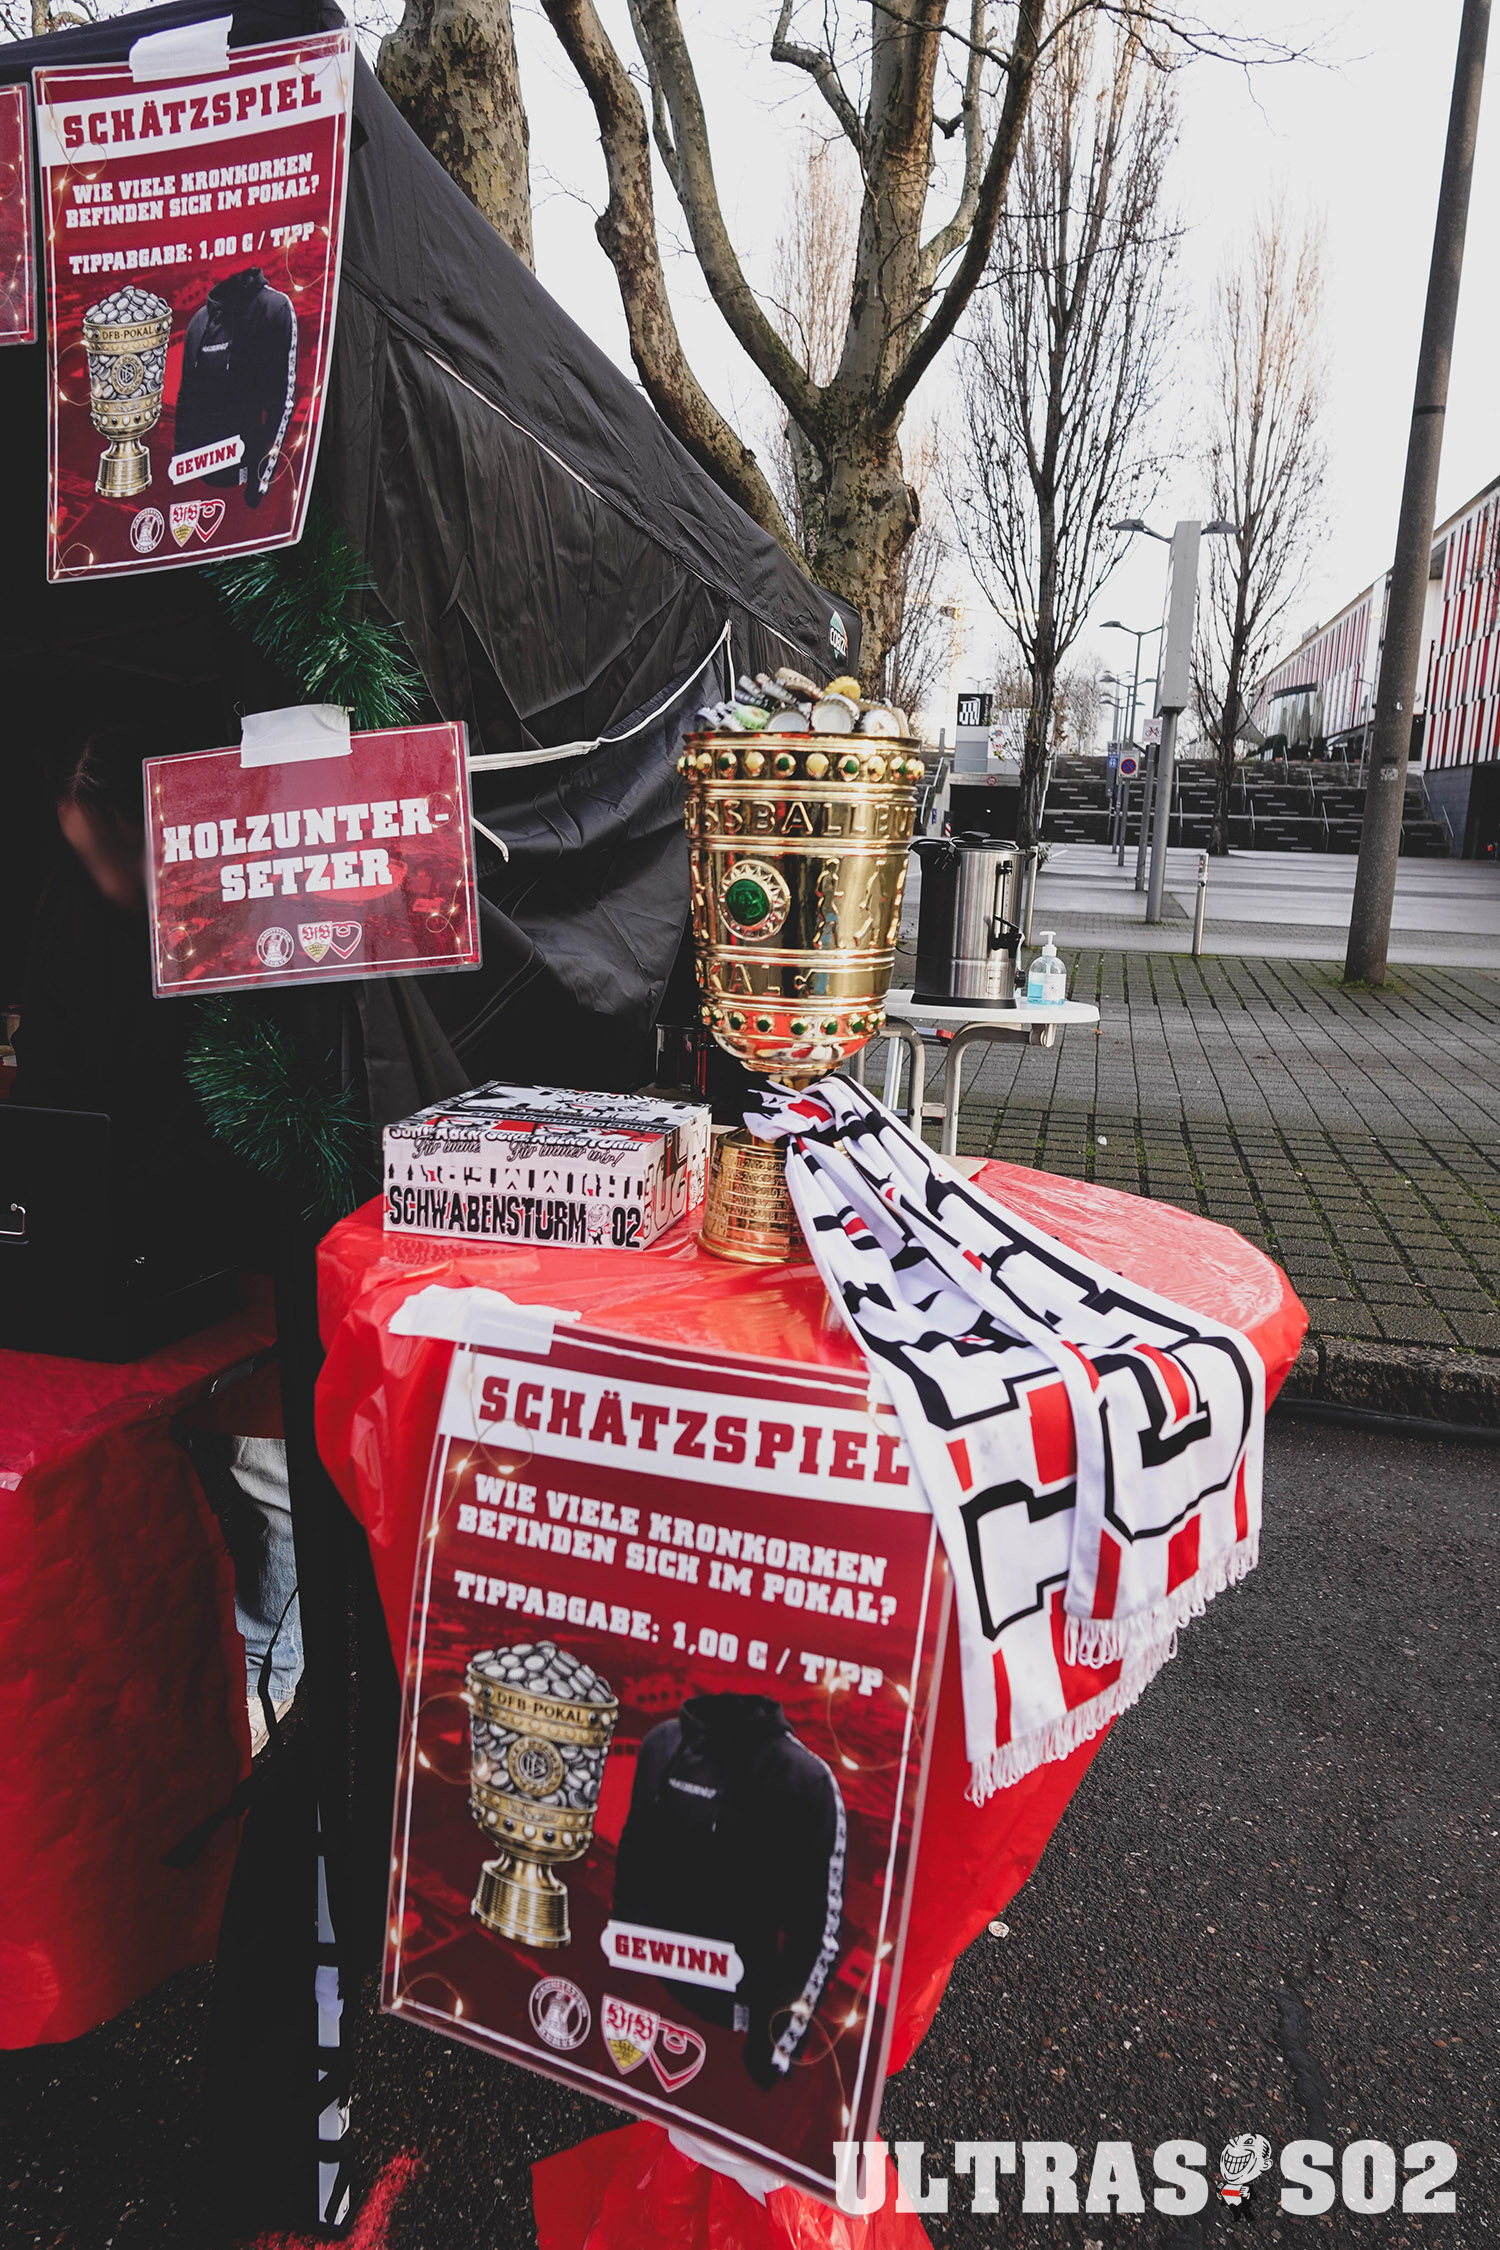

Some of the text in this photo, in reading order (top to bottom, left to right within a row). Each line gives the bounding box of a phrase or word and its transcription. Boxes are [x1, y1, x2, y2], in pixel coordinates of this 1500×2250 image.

[63, 73, 322, 149] SCHÄTZSPIEL
[66, 174, 320, 228] BEFINDEN SICH IM POKAL?
[73, 152, 313, 204] WIE VIELE KRONKORKEN
[69, 243, 193, 274] TIPPABGABE:
[199, 235, 237, 261] 1,00
[270, 221, 315, 248] TIPP
[102, 326, 154, 340] DFB-POKAL
[175, 443, 237, 477] GEWINN
[163, 797, 449, 863] HOLZUNTER-
[220, 848, 393, 902] SETZER
[388, 1185, 643, 1249] SCHWABENSTURM 02
[479, 1375, 911, 1486] SCHÄTZSPIEL
[475, 1473, 888, 1588] WIE VIELE KRONKORKEN
[457, 1503, 898, 1626] BEFINDEN SICH IM POKAL?
[454, 1569, 660, 1644] TIPPABGABE:
[672, 1620, 739, 1663] 1,00
[775, 1647, 791, 1675] /
[800, 1651, 884, 1697] TIPP
[615, 1933, 729, 1978] GEWINN
